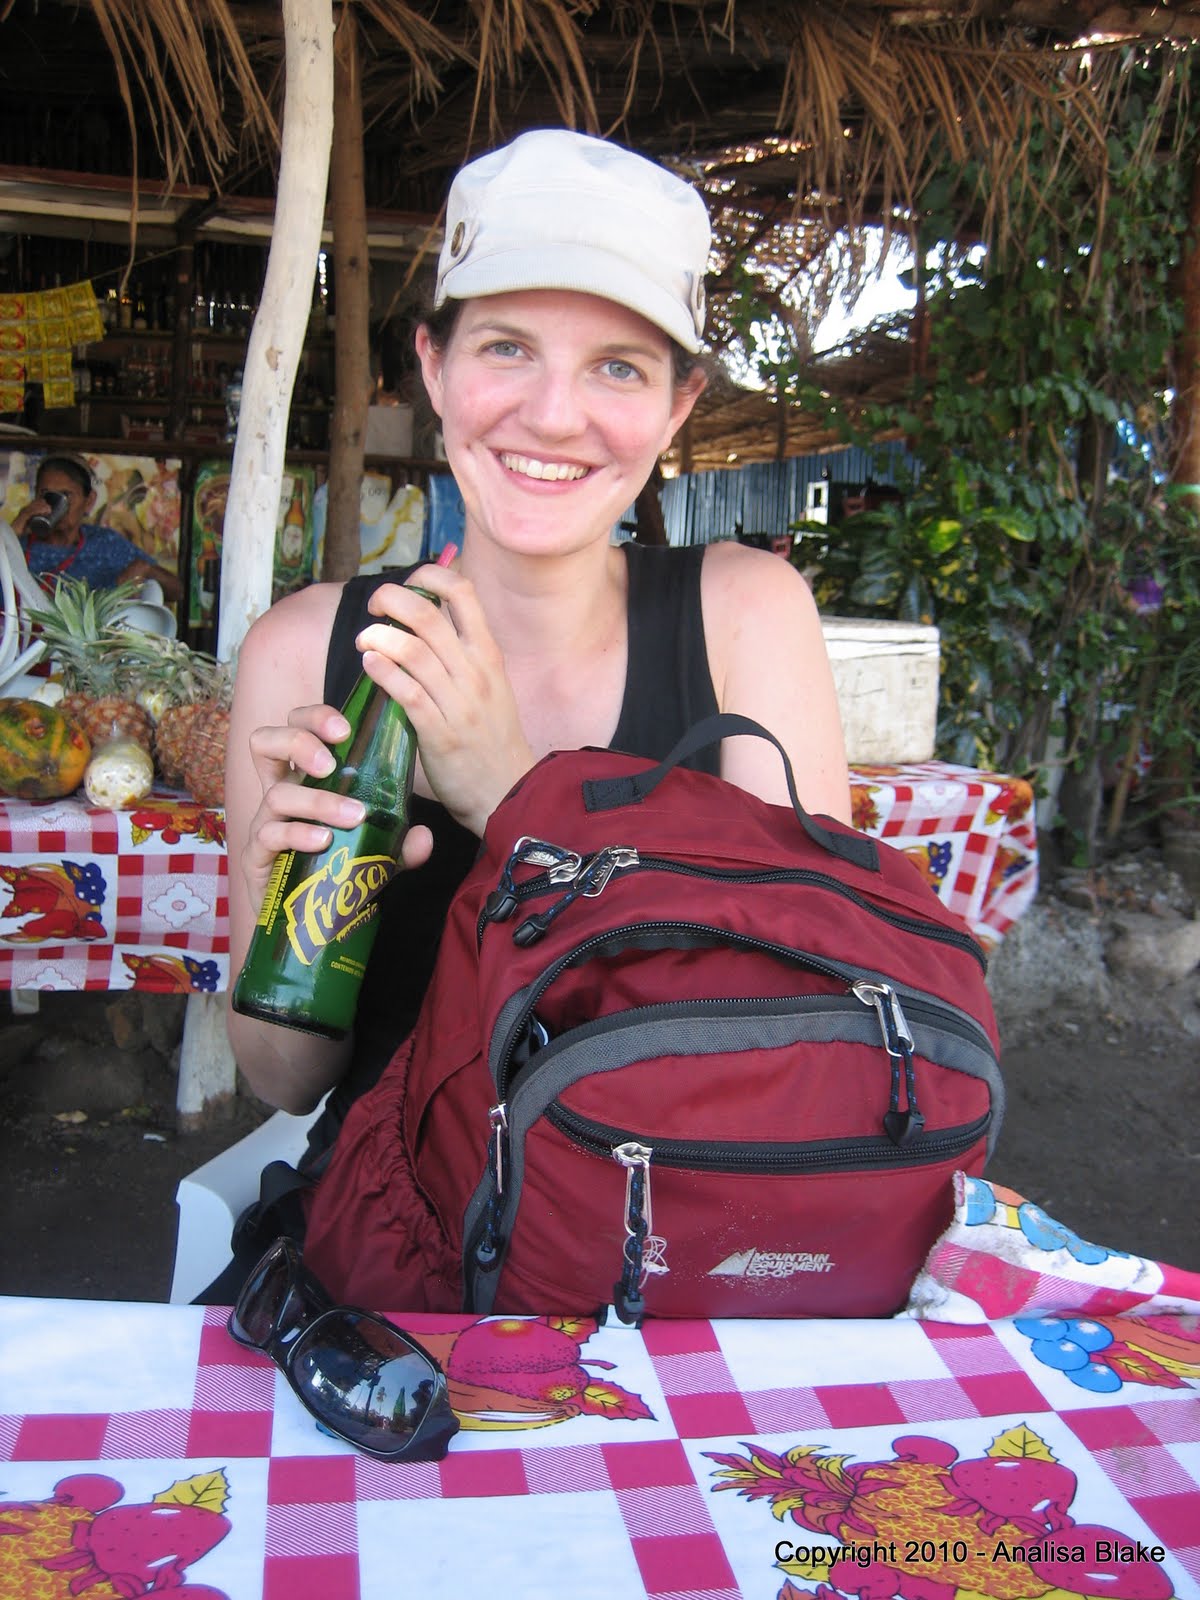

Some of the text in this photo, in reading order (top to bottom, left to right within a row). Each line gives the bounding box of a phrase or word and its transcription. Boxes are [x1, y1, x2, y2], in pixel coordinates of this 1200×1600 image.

[754, 1252, 831, 1263] MOUNTAIN
[749, 1261, 836, 1273] EQUIPMENT
[746, 1268, 794, 1278] CO-OP
